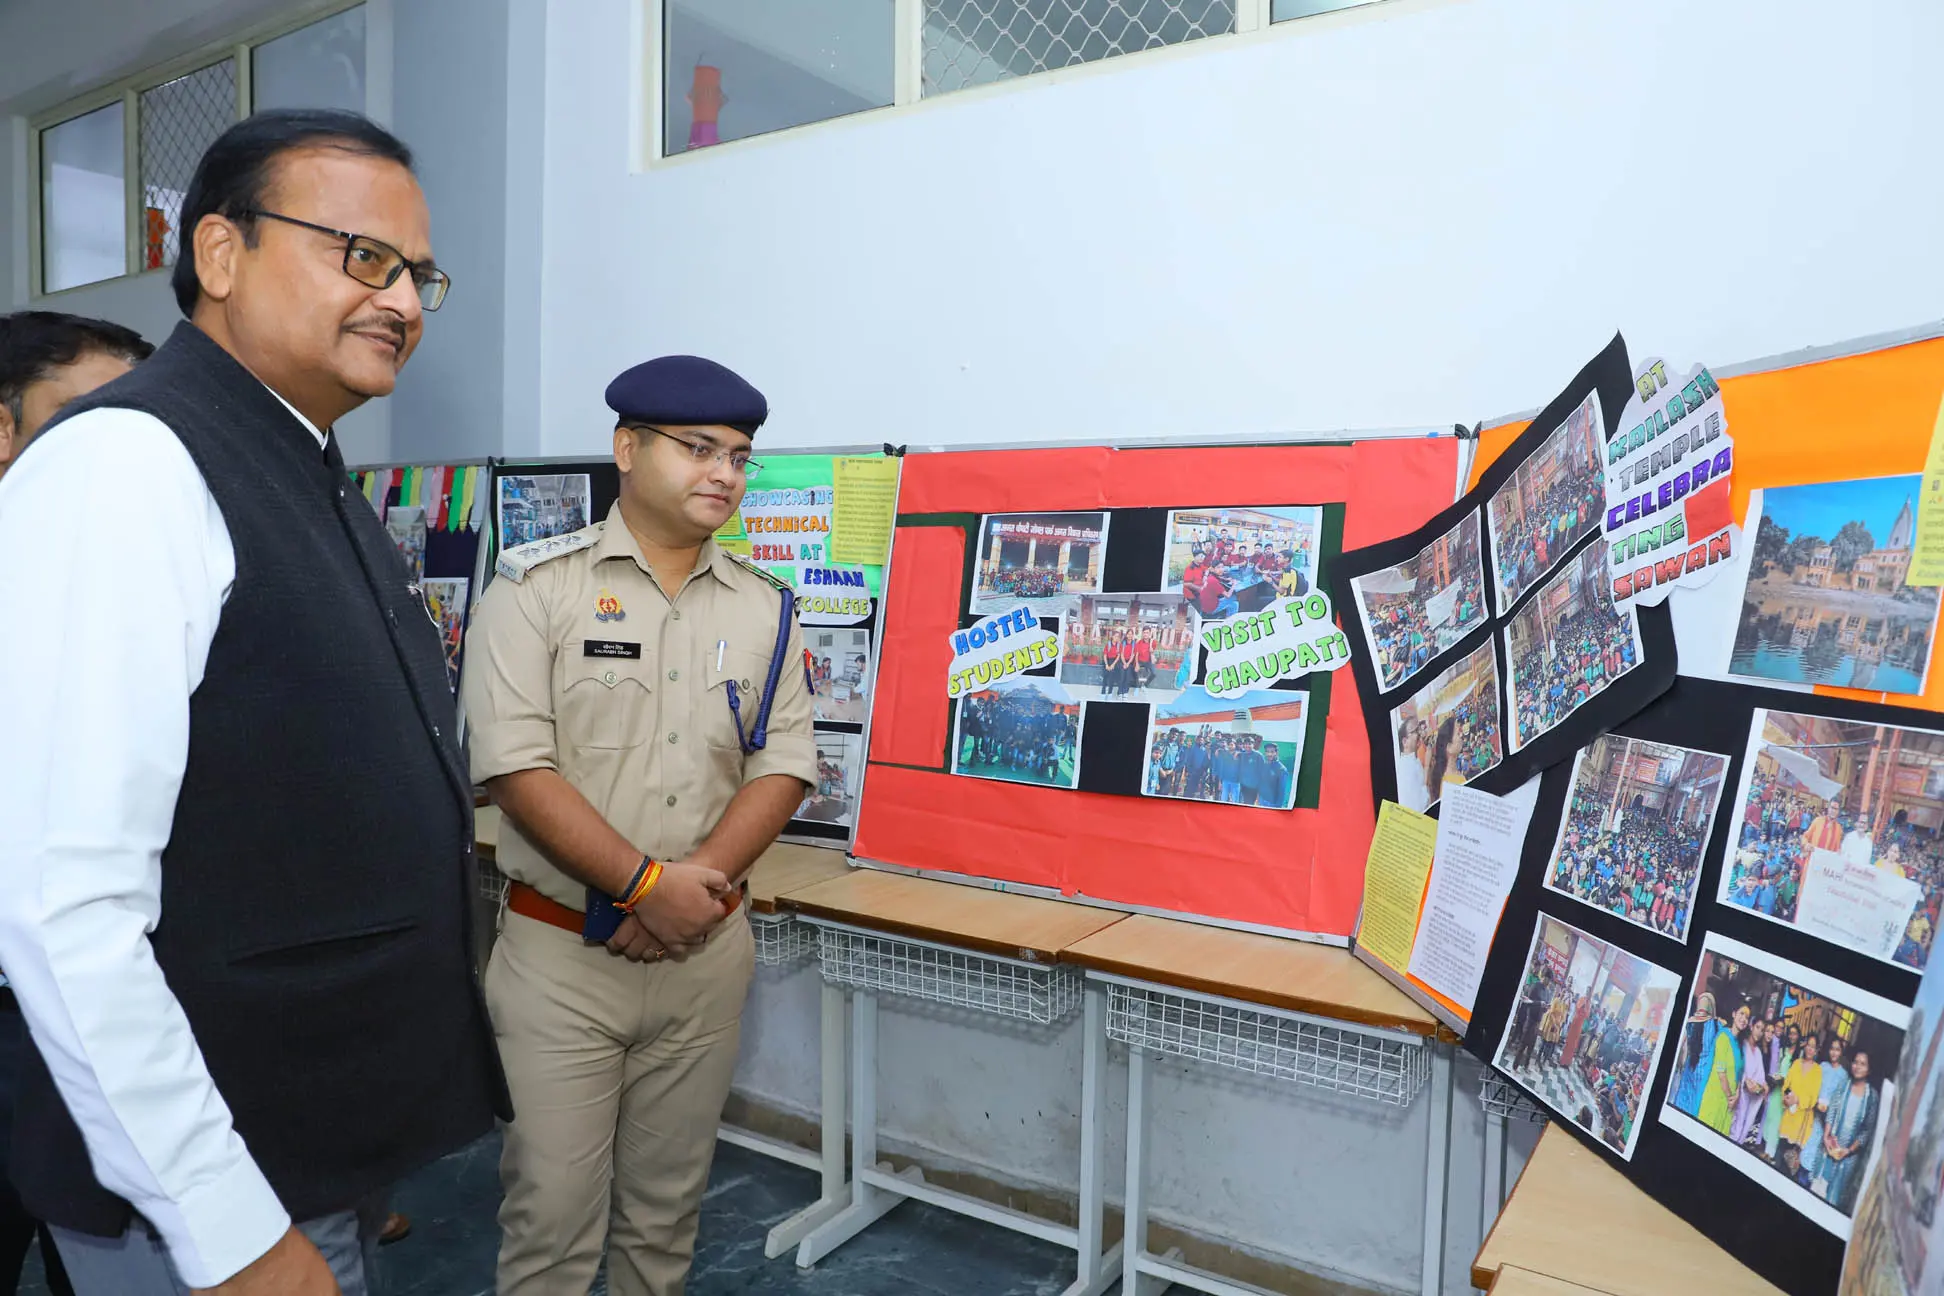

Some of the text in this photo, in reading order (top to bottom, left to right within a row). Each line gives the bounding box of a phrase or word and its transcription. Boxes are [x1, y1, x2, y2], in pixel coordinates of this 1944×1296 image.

[1636, 360, 1668, 403] AT
[1609, 368, 1720, 466] KAILASH
[1619, 411, 1720, 492] TEMPLE
[1606, 447, 1732, 532] CELEBRA
[745, 516, 829, 533] TECHNICAL
[1612, 513, 1685, 565] TING
[800, 544, 822, 560] AT
[1613, 531, 1732, 602] SAWAN
[804, 568, 864, 587] ESHAAN
[802, 597, 868, 616] COLLEGE
[1285, 595, 1327, 627] TO
[955, 607, 1037, 656] HOSTEL
[950, 636, 1059, 695] STUDENTS
